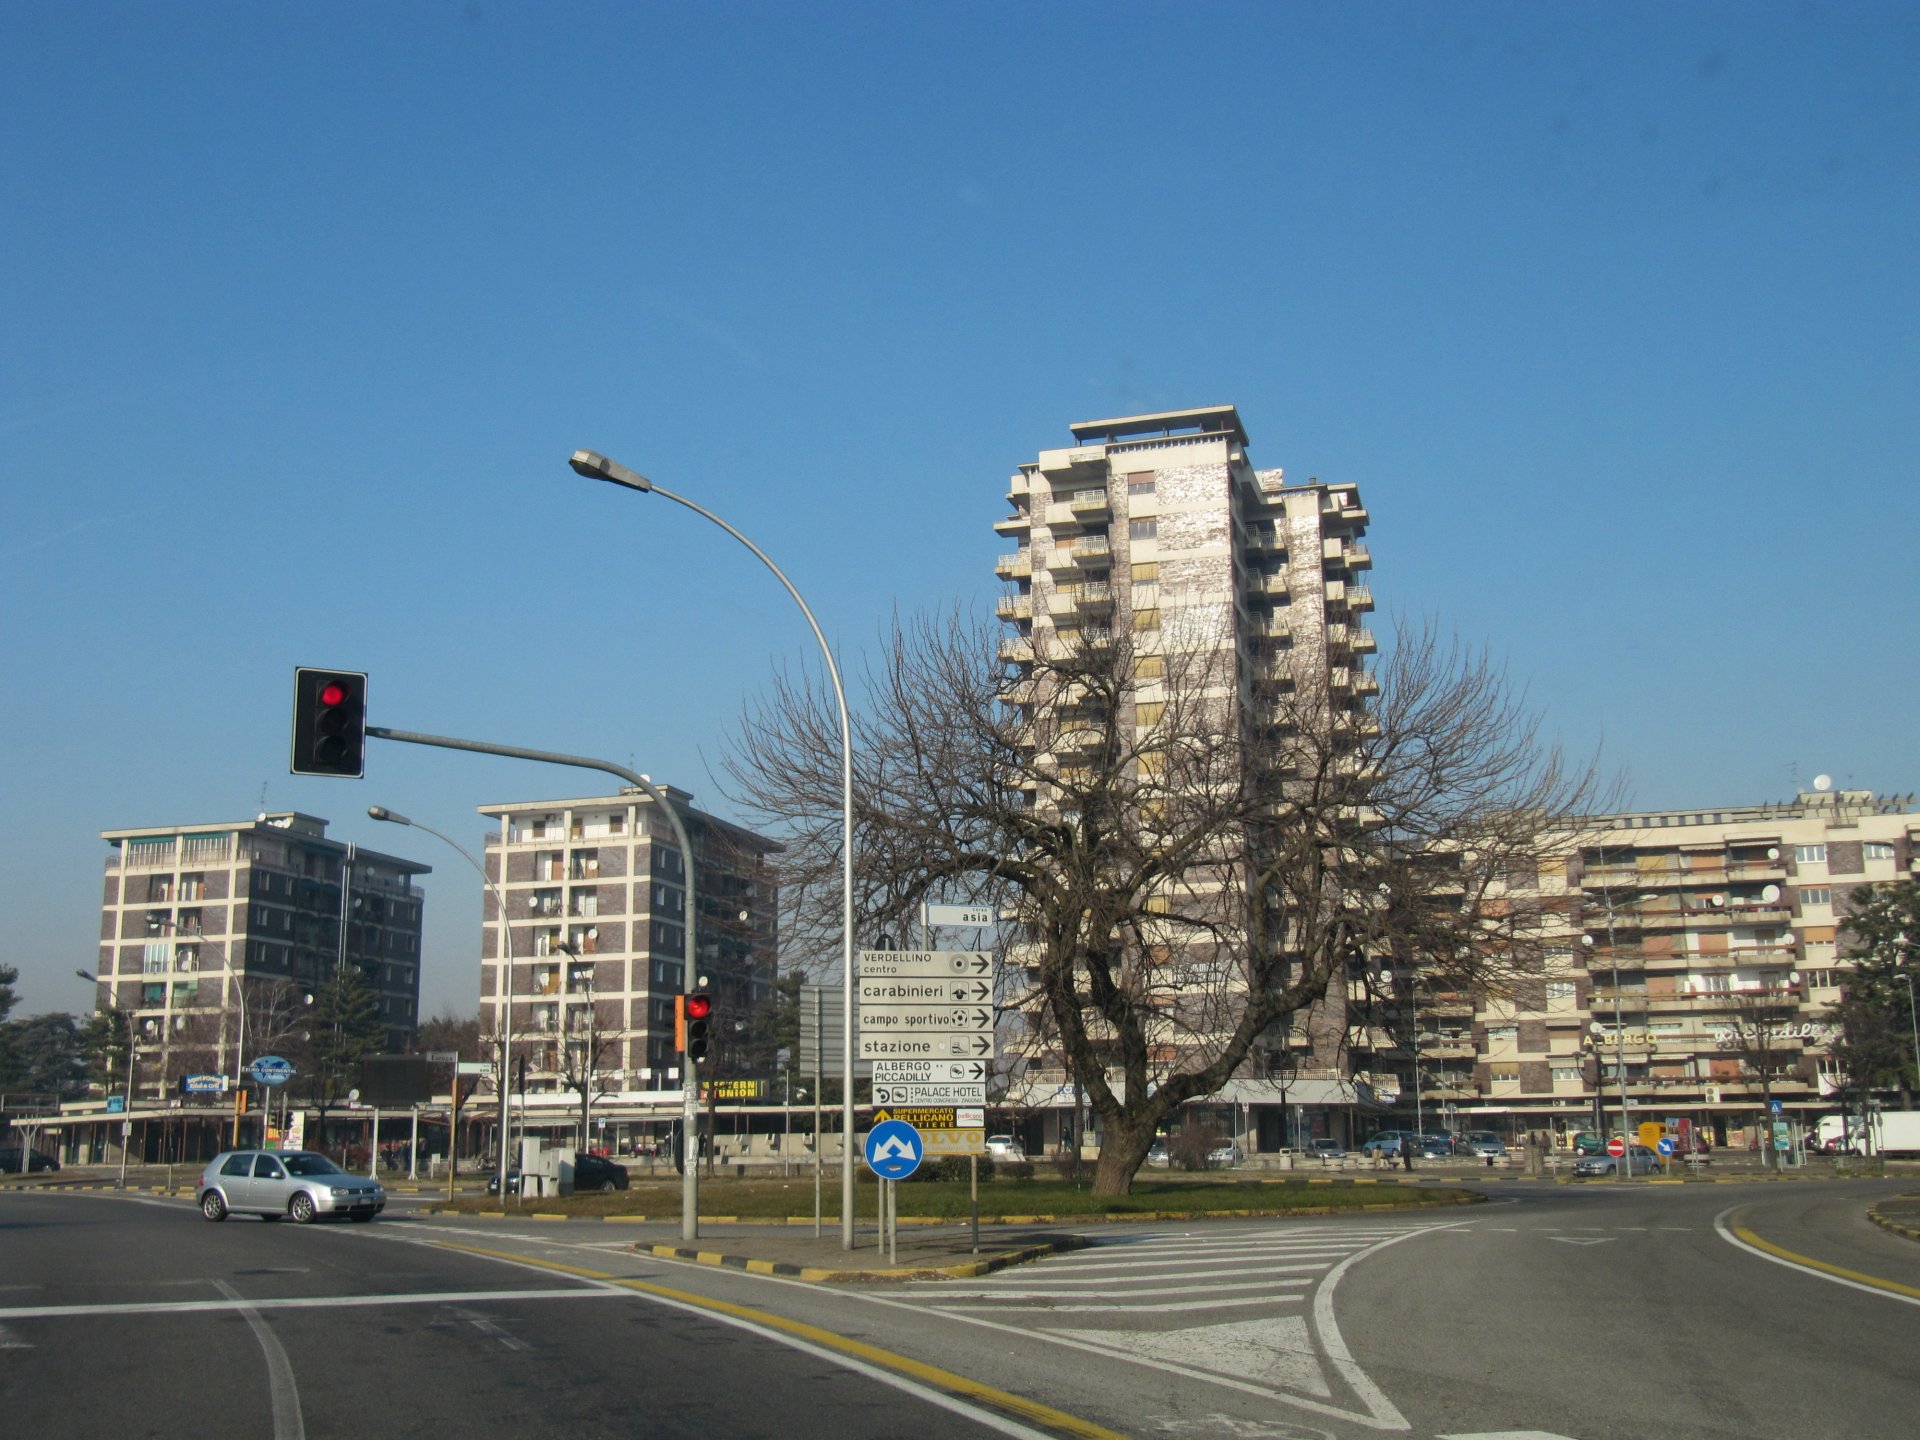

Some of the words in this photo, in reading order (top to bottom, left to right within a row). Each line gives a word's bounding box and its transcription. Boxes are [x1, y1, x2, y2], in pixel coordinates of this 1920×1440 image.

[962, 912, 988, 922] asia
[864, 953, 932, 963] VERDELLINO
[863, 965, 897, 973] centro
[863, 985, 943, 997] carabinieri
[863, 1015, 899, 1027] campo
[904, 1013, 950, 1027] sportivo
[1583, 1033, 1658, 1046] ABERGO
[864, 1040, 931, 1053] stazione
[876, 1061, 931, 1071] ALBERGO
[874, 1072, 932, 1082] PICCADILLY
[718, 1089, 755, 1098] UNION
[914, 1087, 951, 1097] PALACE
[953, 1087, 982, 1097] HOTEL
[892, 1107, 954, 1115] SUPERMERCATO
[892, 1114, 954, 1122] PELLICANO
